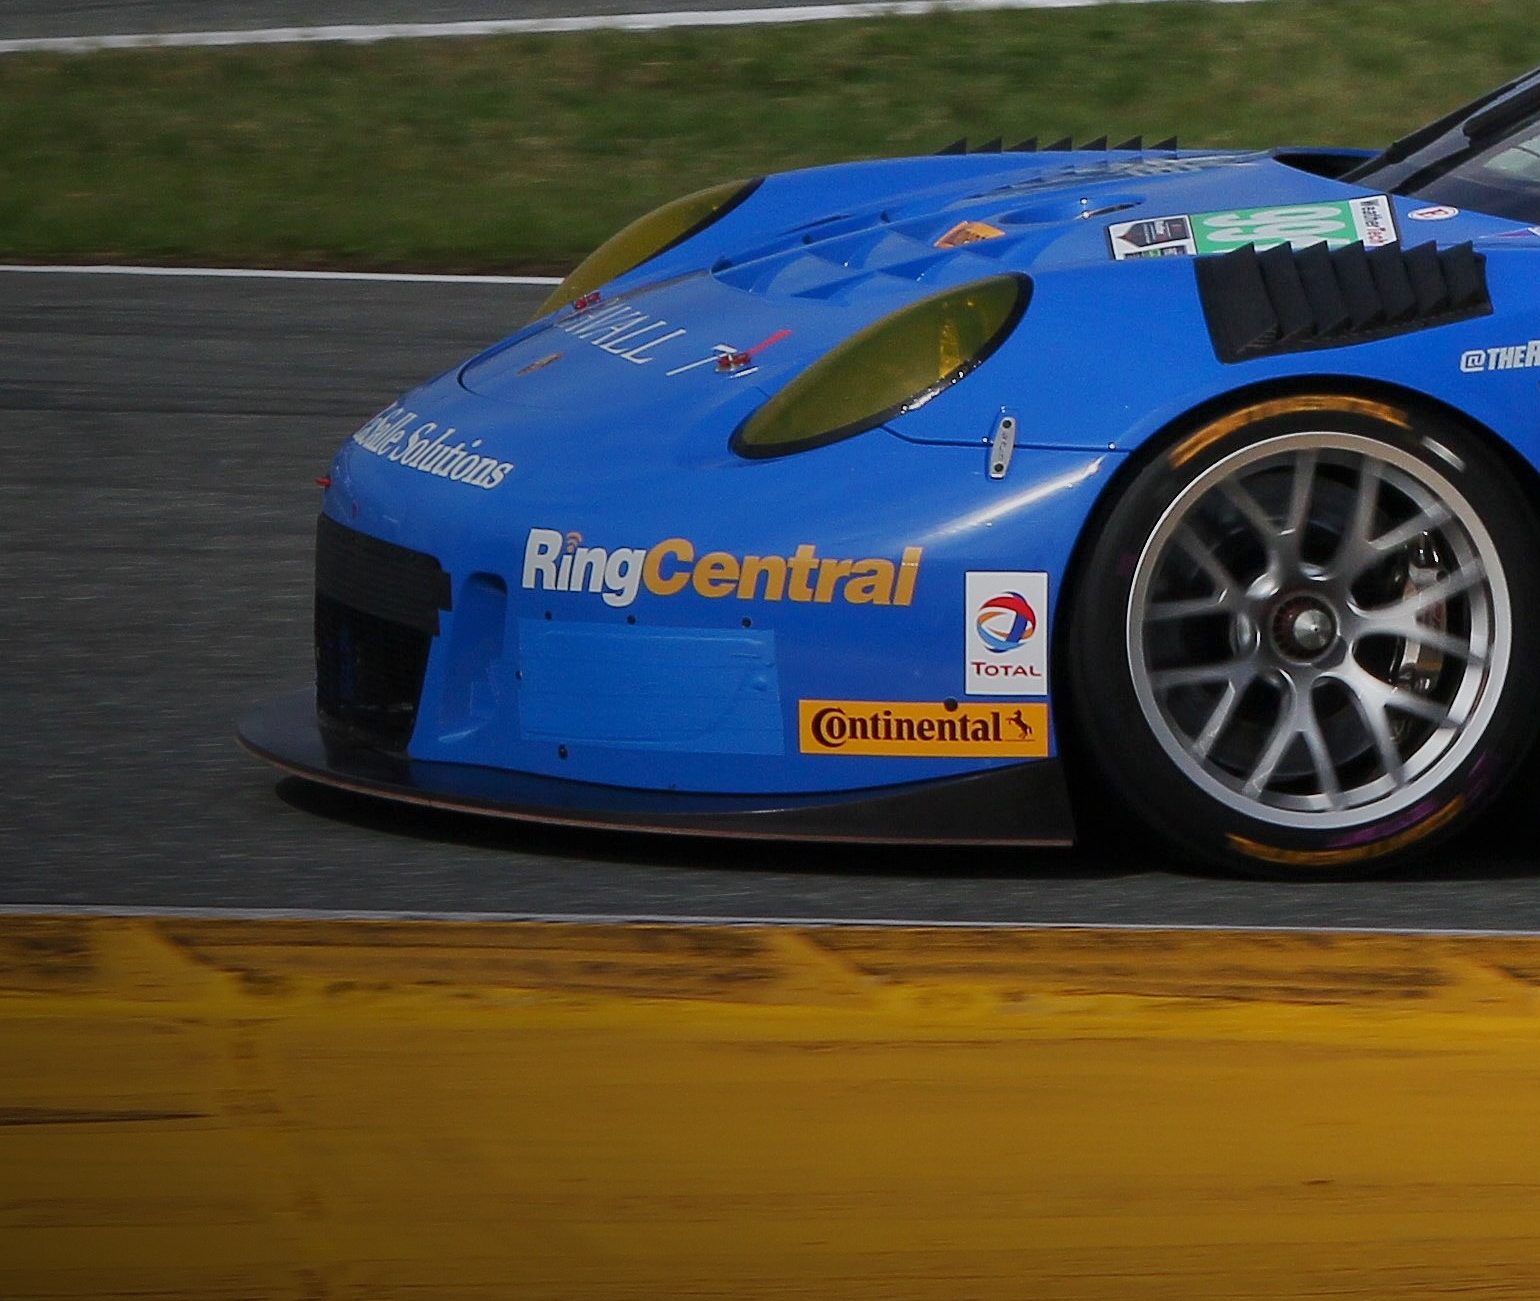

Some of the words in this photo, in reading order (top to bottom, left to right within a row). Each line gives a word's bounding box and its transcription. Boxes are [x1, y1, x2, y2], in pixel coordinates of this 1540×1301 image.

[388, 422, 515, 489] Solutions
[522, 529, 924, 607] RingCentral
[971, 661, 1042, 677] TOTAL
[811, 707, 1003, 748] Continental
